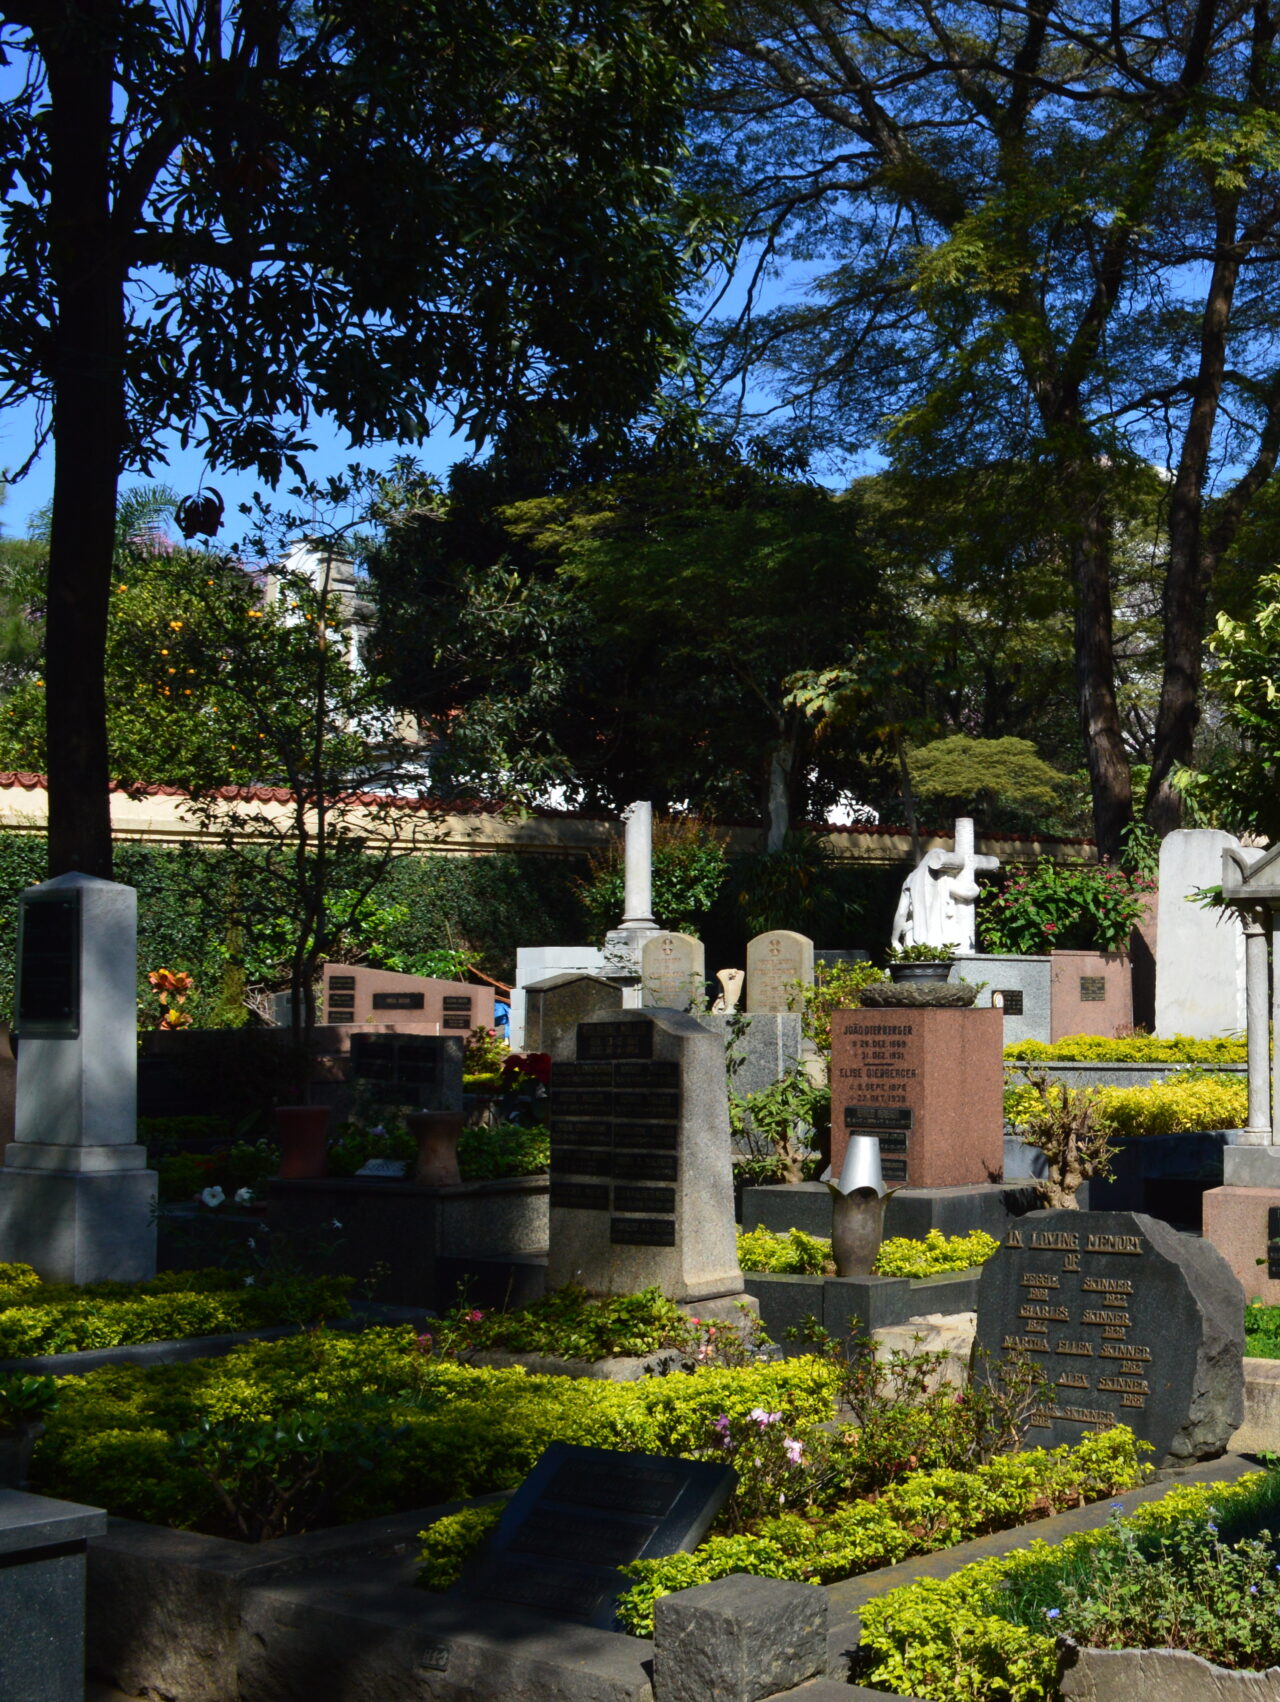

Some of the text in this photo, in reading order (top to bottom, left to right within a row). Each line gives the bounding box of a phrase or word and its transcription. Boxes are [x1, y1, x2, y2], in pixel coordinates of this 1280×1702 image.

[843, 1023, 864, 1036] JOÃO
[839, 1068, 862, 1078] ELISE
[1007, 1230, 1144, 1252] IN LOVING MEMORY
[1064, 1254, 1081, 1270] OF
[1083, 1277, 1133, 1292] SKINNER
[1020, 1304, 1131, 1324] CHARLES SKINNER
[1003, 1336, 1151, 1359] MARTHA ELLEN SKINNER
[1059, 1372, 1150, 1392] ALEX SKINNER
[1063, 1407, 1116, 1423] SKINNER
